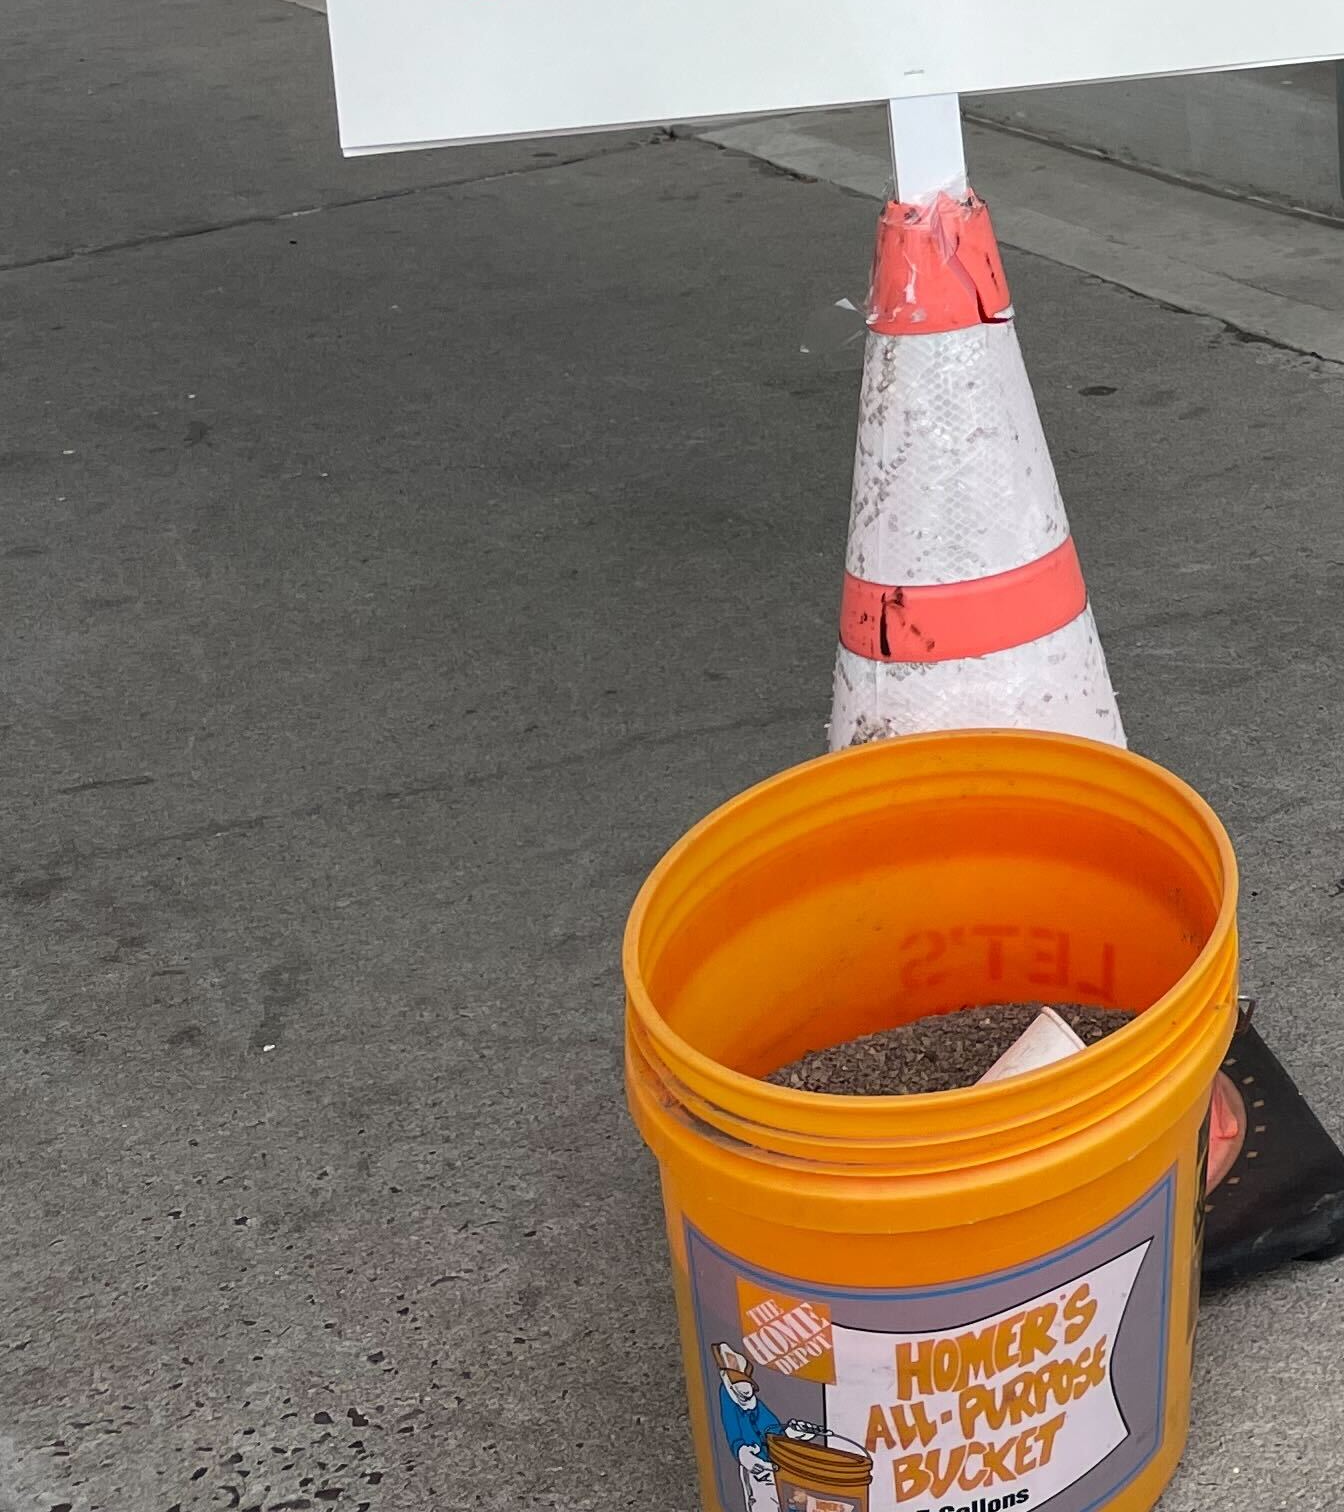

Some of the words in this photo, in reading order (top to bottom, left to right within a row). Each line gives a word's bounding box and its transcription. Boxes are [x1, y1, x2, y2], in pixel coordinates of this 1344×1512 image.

[742, 1301, 831, 1366] HOME
[746, 1299, 783, 1326] THE
[895, 1283, 1098, 1401] HOMER'S
[774, 1331, 833, 1376] DEPOT
[865, 1334, 1108, 1454] ALL-PURPOSE
[892, 1411, 1068, 1503] BUCKET
